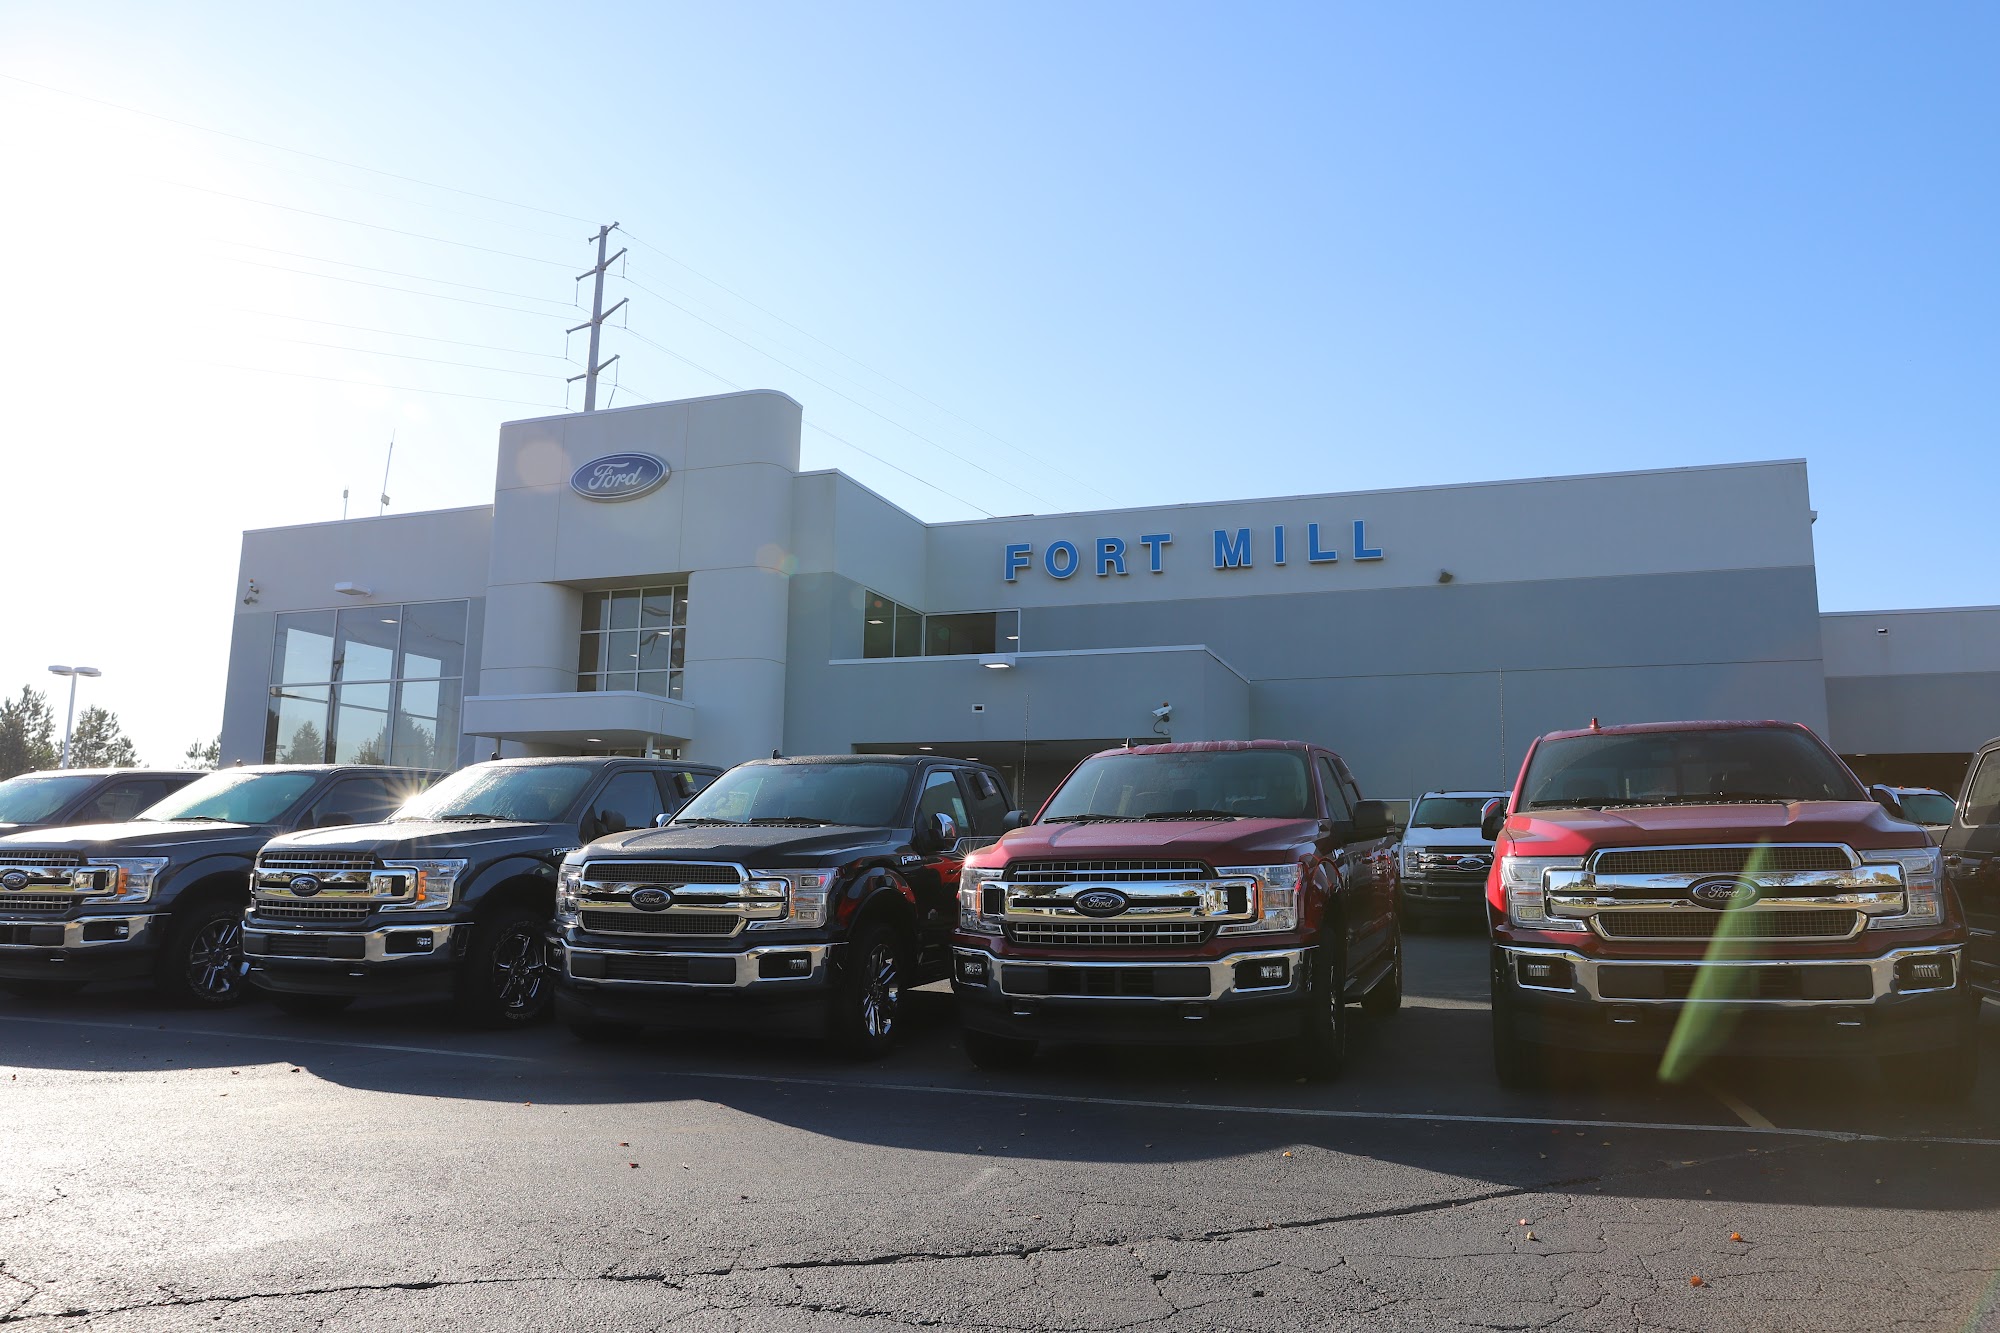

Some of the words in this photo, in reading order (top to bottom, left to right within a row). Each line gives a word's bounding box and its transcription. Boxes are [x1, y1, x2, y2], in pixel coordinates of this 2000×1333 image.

[587, 461, 644, 490] Ford
[1004, 532, 1174, 582] FORT
[1213, 519, 1384, 568] MILL
[1087, 896, 1114, 908] Ford
[1707, 884, 1741, 899] Ford
